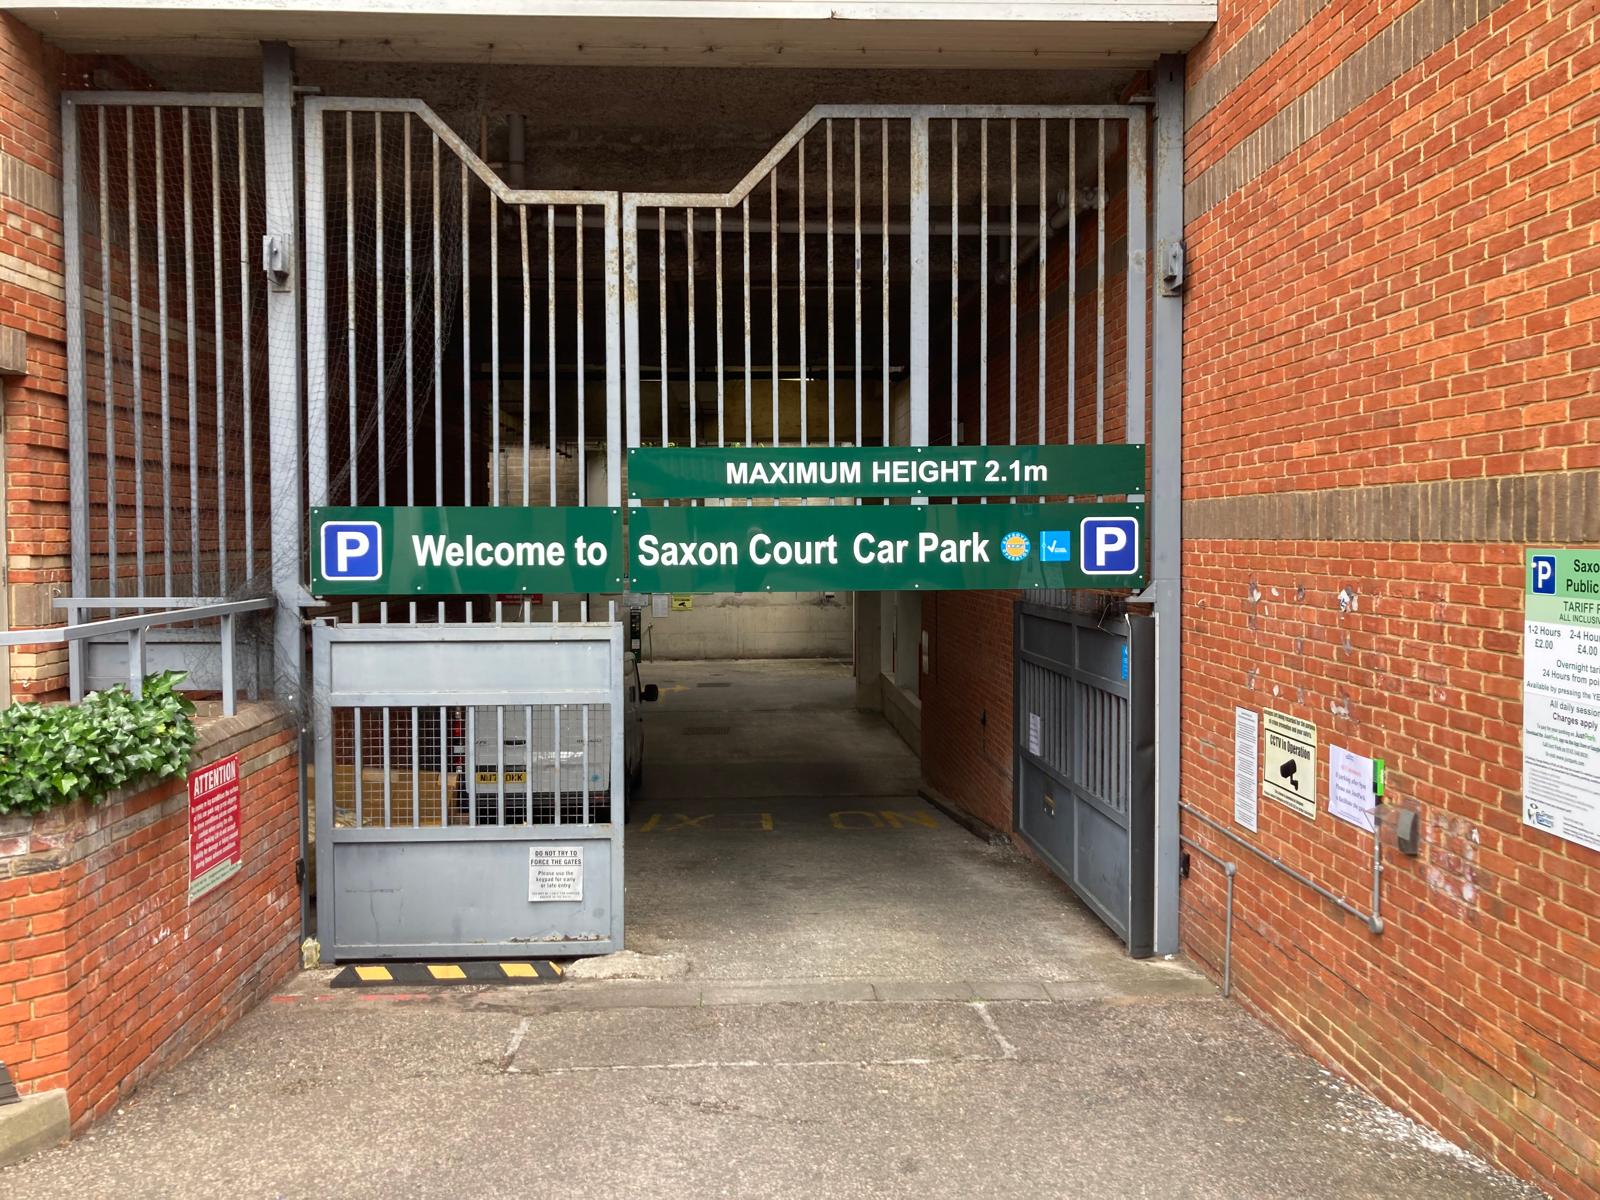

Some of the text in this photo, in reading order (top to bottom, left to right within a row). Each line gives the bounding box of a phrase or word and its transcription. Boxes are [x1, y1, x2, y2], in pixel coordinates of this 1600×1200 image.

[726, 459, 1048, 485] MAXIMUM HEIGHT 2.1m
[337, 531, 370, 572] P
[412, 535, 608, 566] Welcome to
[638, 532, 990, 566] Saxon Court Car Park
[1096, 527, 1126, 566] P
[1537, 560, 1552, 589] P
[1574, 559, 1600, 574] Saxo
[1566, 579, 1600, 594] Public
[1563, 601, 1594, 614] TARIFF
[1559, 612, 1571, 622] ALL
[1528, 624, 1562, 638] 1-2 Hours
[1570, 630, 1582, 640] 2-4
[1534, 638, 1554, 650] £2.00
[1577, 644, 1598, 656] £4.00
[1556, 660, 1589, 674] Overnight
[1542, 668, 1550, 678] 24
[1551, 670, 1570, 681] Hours
[1572, 674, 1588, 684] from
[1526, 680, 1550, 691] Available
[1550, 686, 1557, 694] by
[1558, 688, 1582, 700] pressing
[1582, 692, 1592, 700] the
[1550, 699, 1558, 709] All
[1560, 702, 1574, 714] daily
[1552, 712, 1598, 732] Charges apply
[1270, 734, 1281, 748] CCTV
[1287, 740, 1310, 760] Operation
[194, 760, 236, 797] ATTENTION
